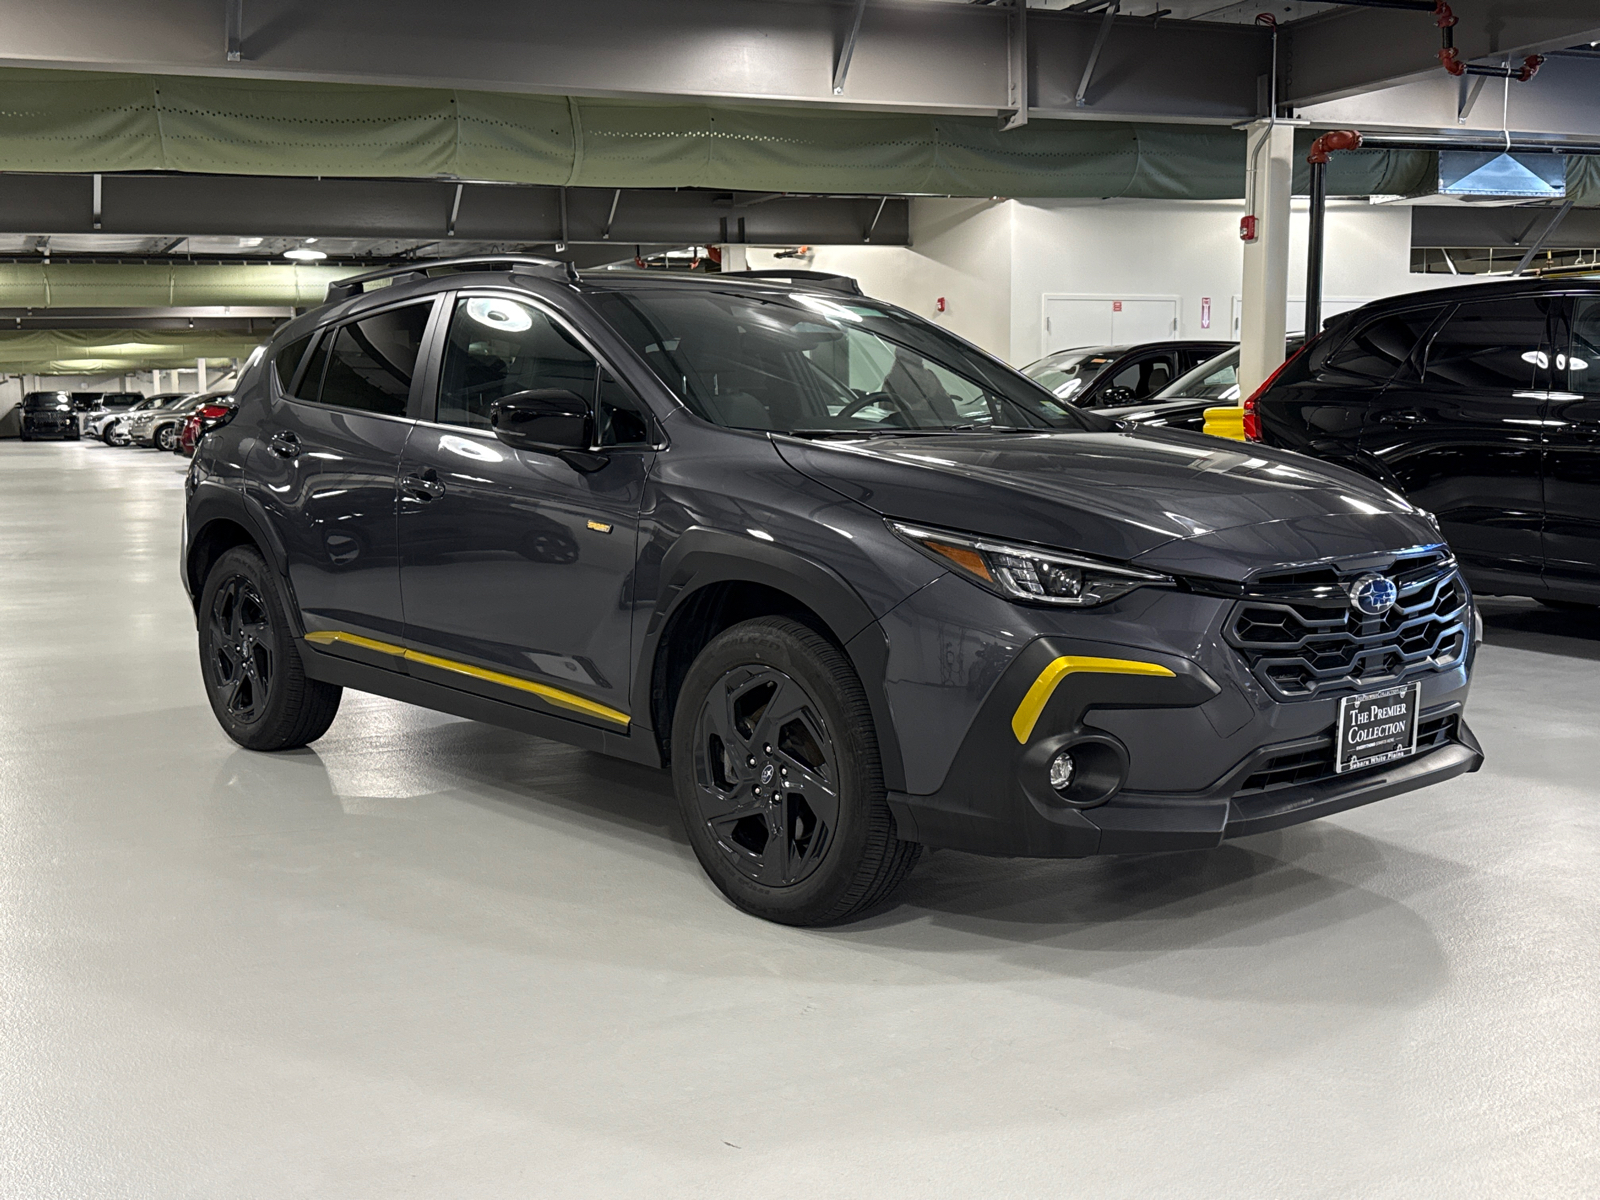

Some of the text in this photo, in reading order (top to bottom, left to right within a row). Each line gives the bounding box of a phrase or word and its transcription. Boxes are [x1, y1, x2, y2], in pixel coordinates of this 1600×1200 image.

[1349, 703, 1407, 726] THE PREMIER
[1348, 720, 1406, 744] COLLECTION
